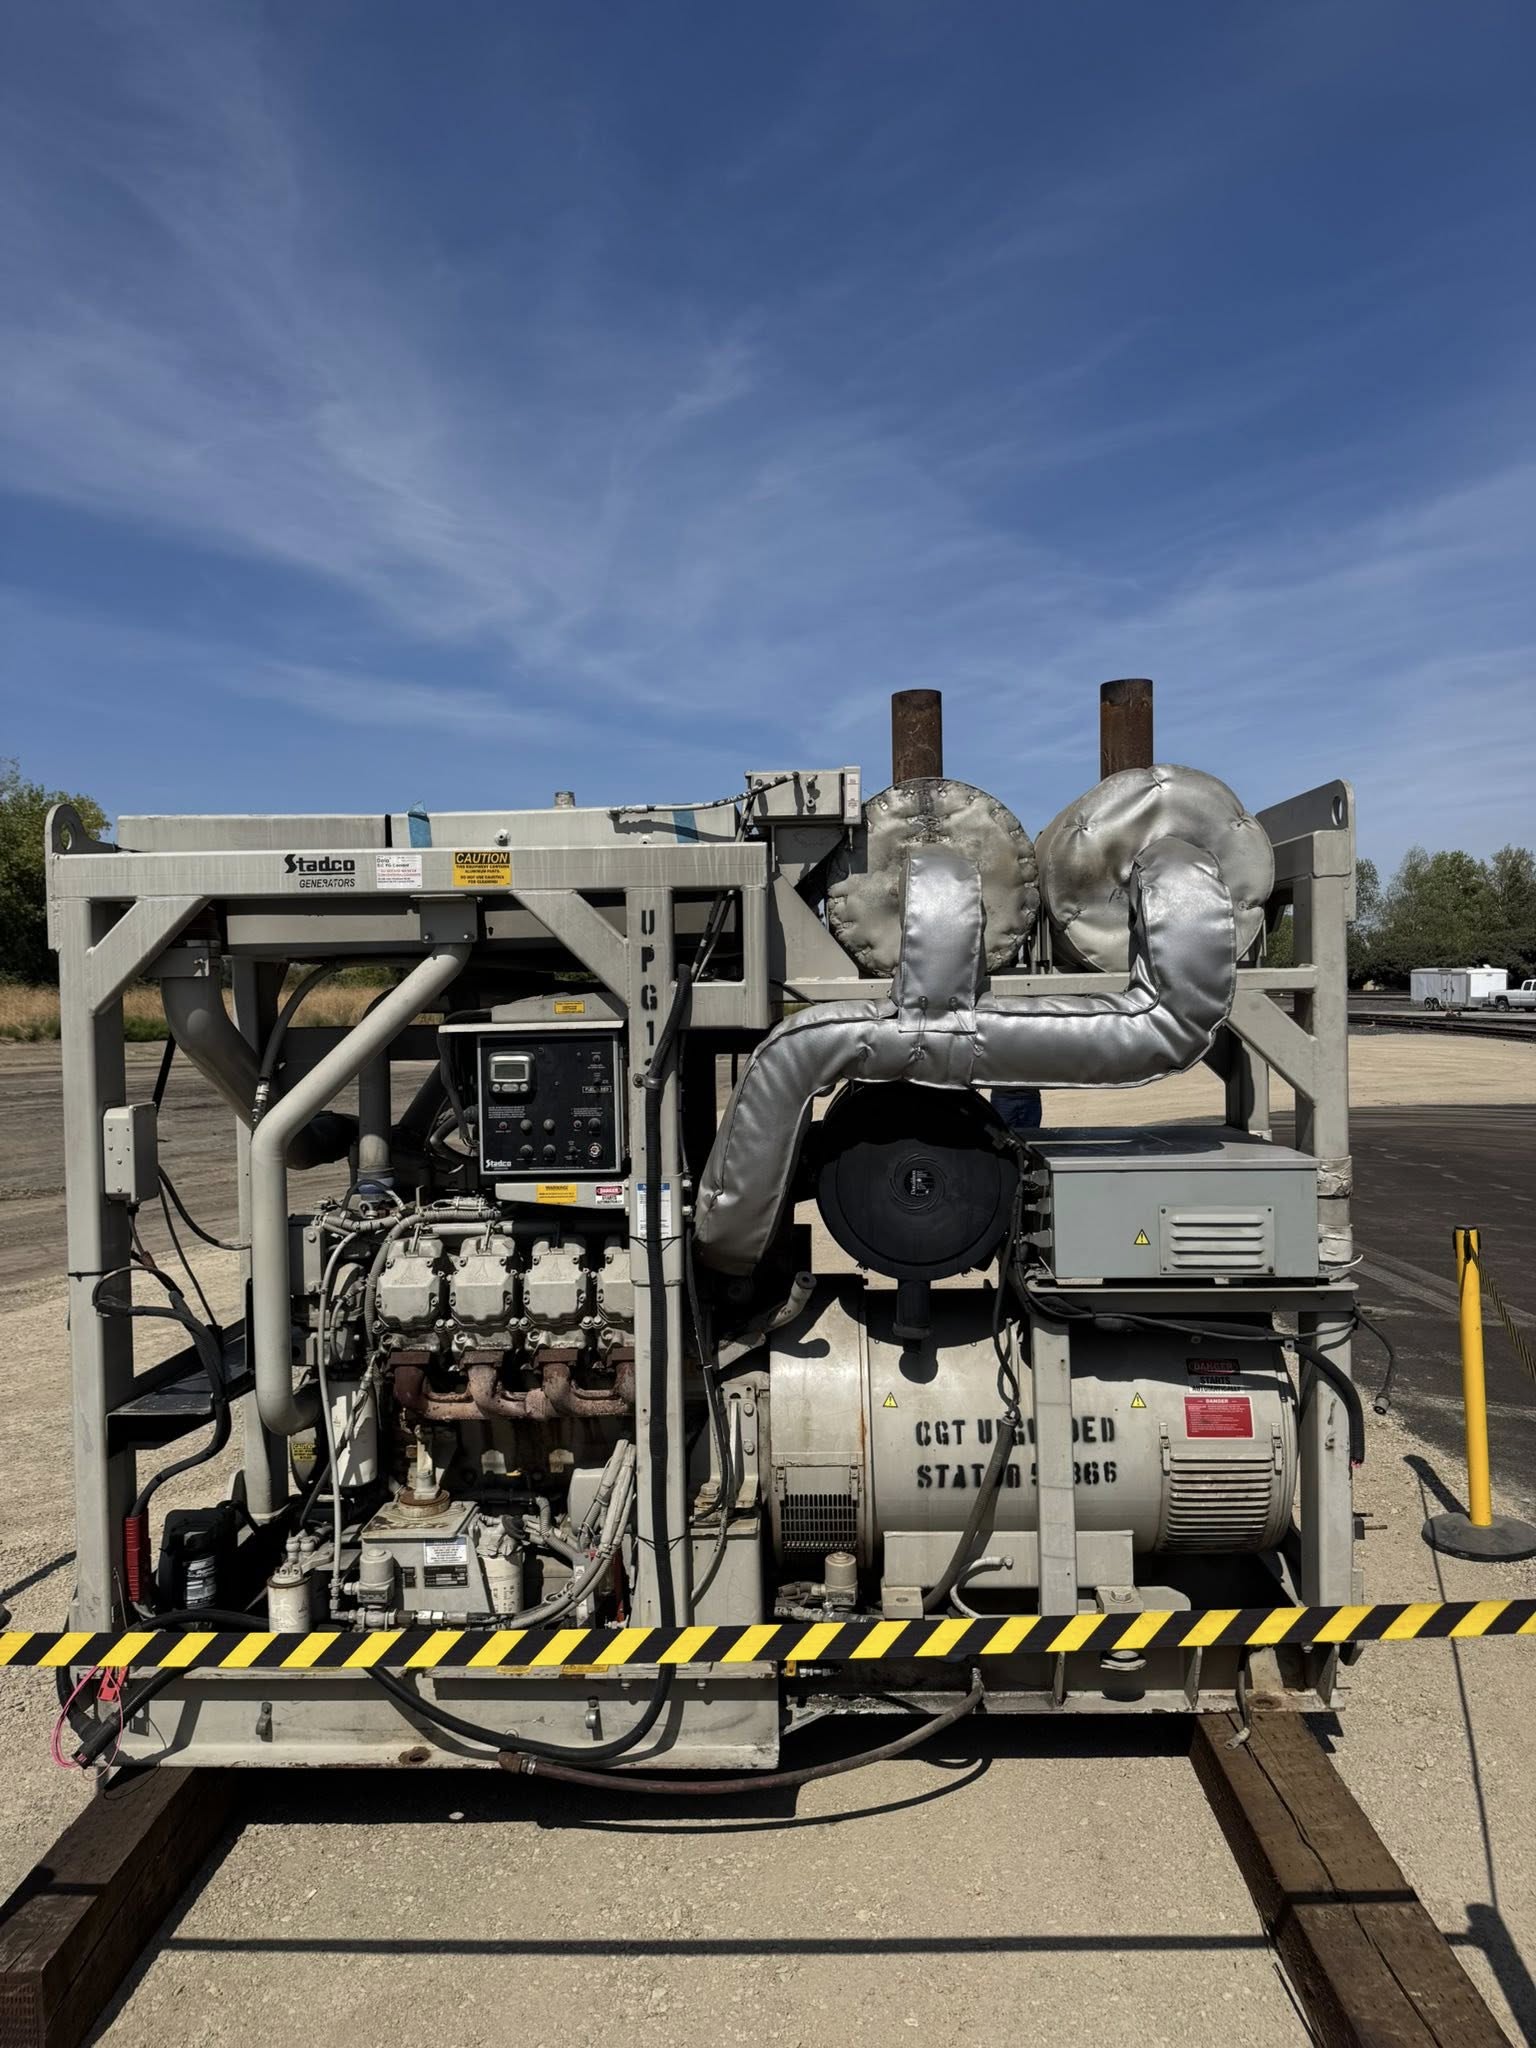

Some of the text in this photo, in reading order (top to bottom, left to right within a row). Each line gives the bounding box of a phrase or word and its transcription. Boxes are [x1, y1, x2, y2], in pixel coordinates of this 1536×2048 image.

[284, 854, 355, 873] Stadco
[456, 853, 508, 864] CAUTION
[299, 878, 355, 888] GENERATORS
[641, 910, 658, 1072] UPG1
[485, 1159, 512, 1168] Stadco
[1194, 1362, 1233, 1370] DANGER
[1200, 1376, 1231, 1384] STARTS
[915, 1419, 966, 1446] CGT
[917, 1464, 1021, 1489] STATR
